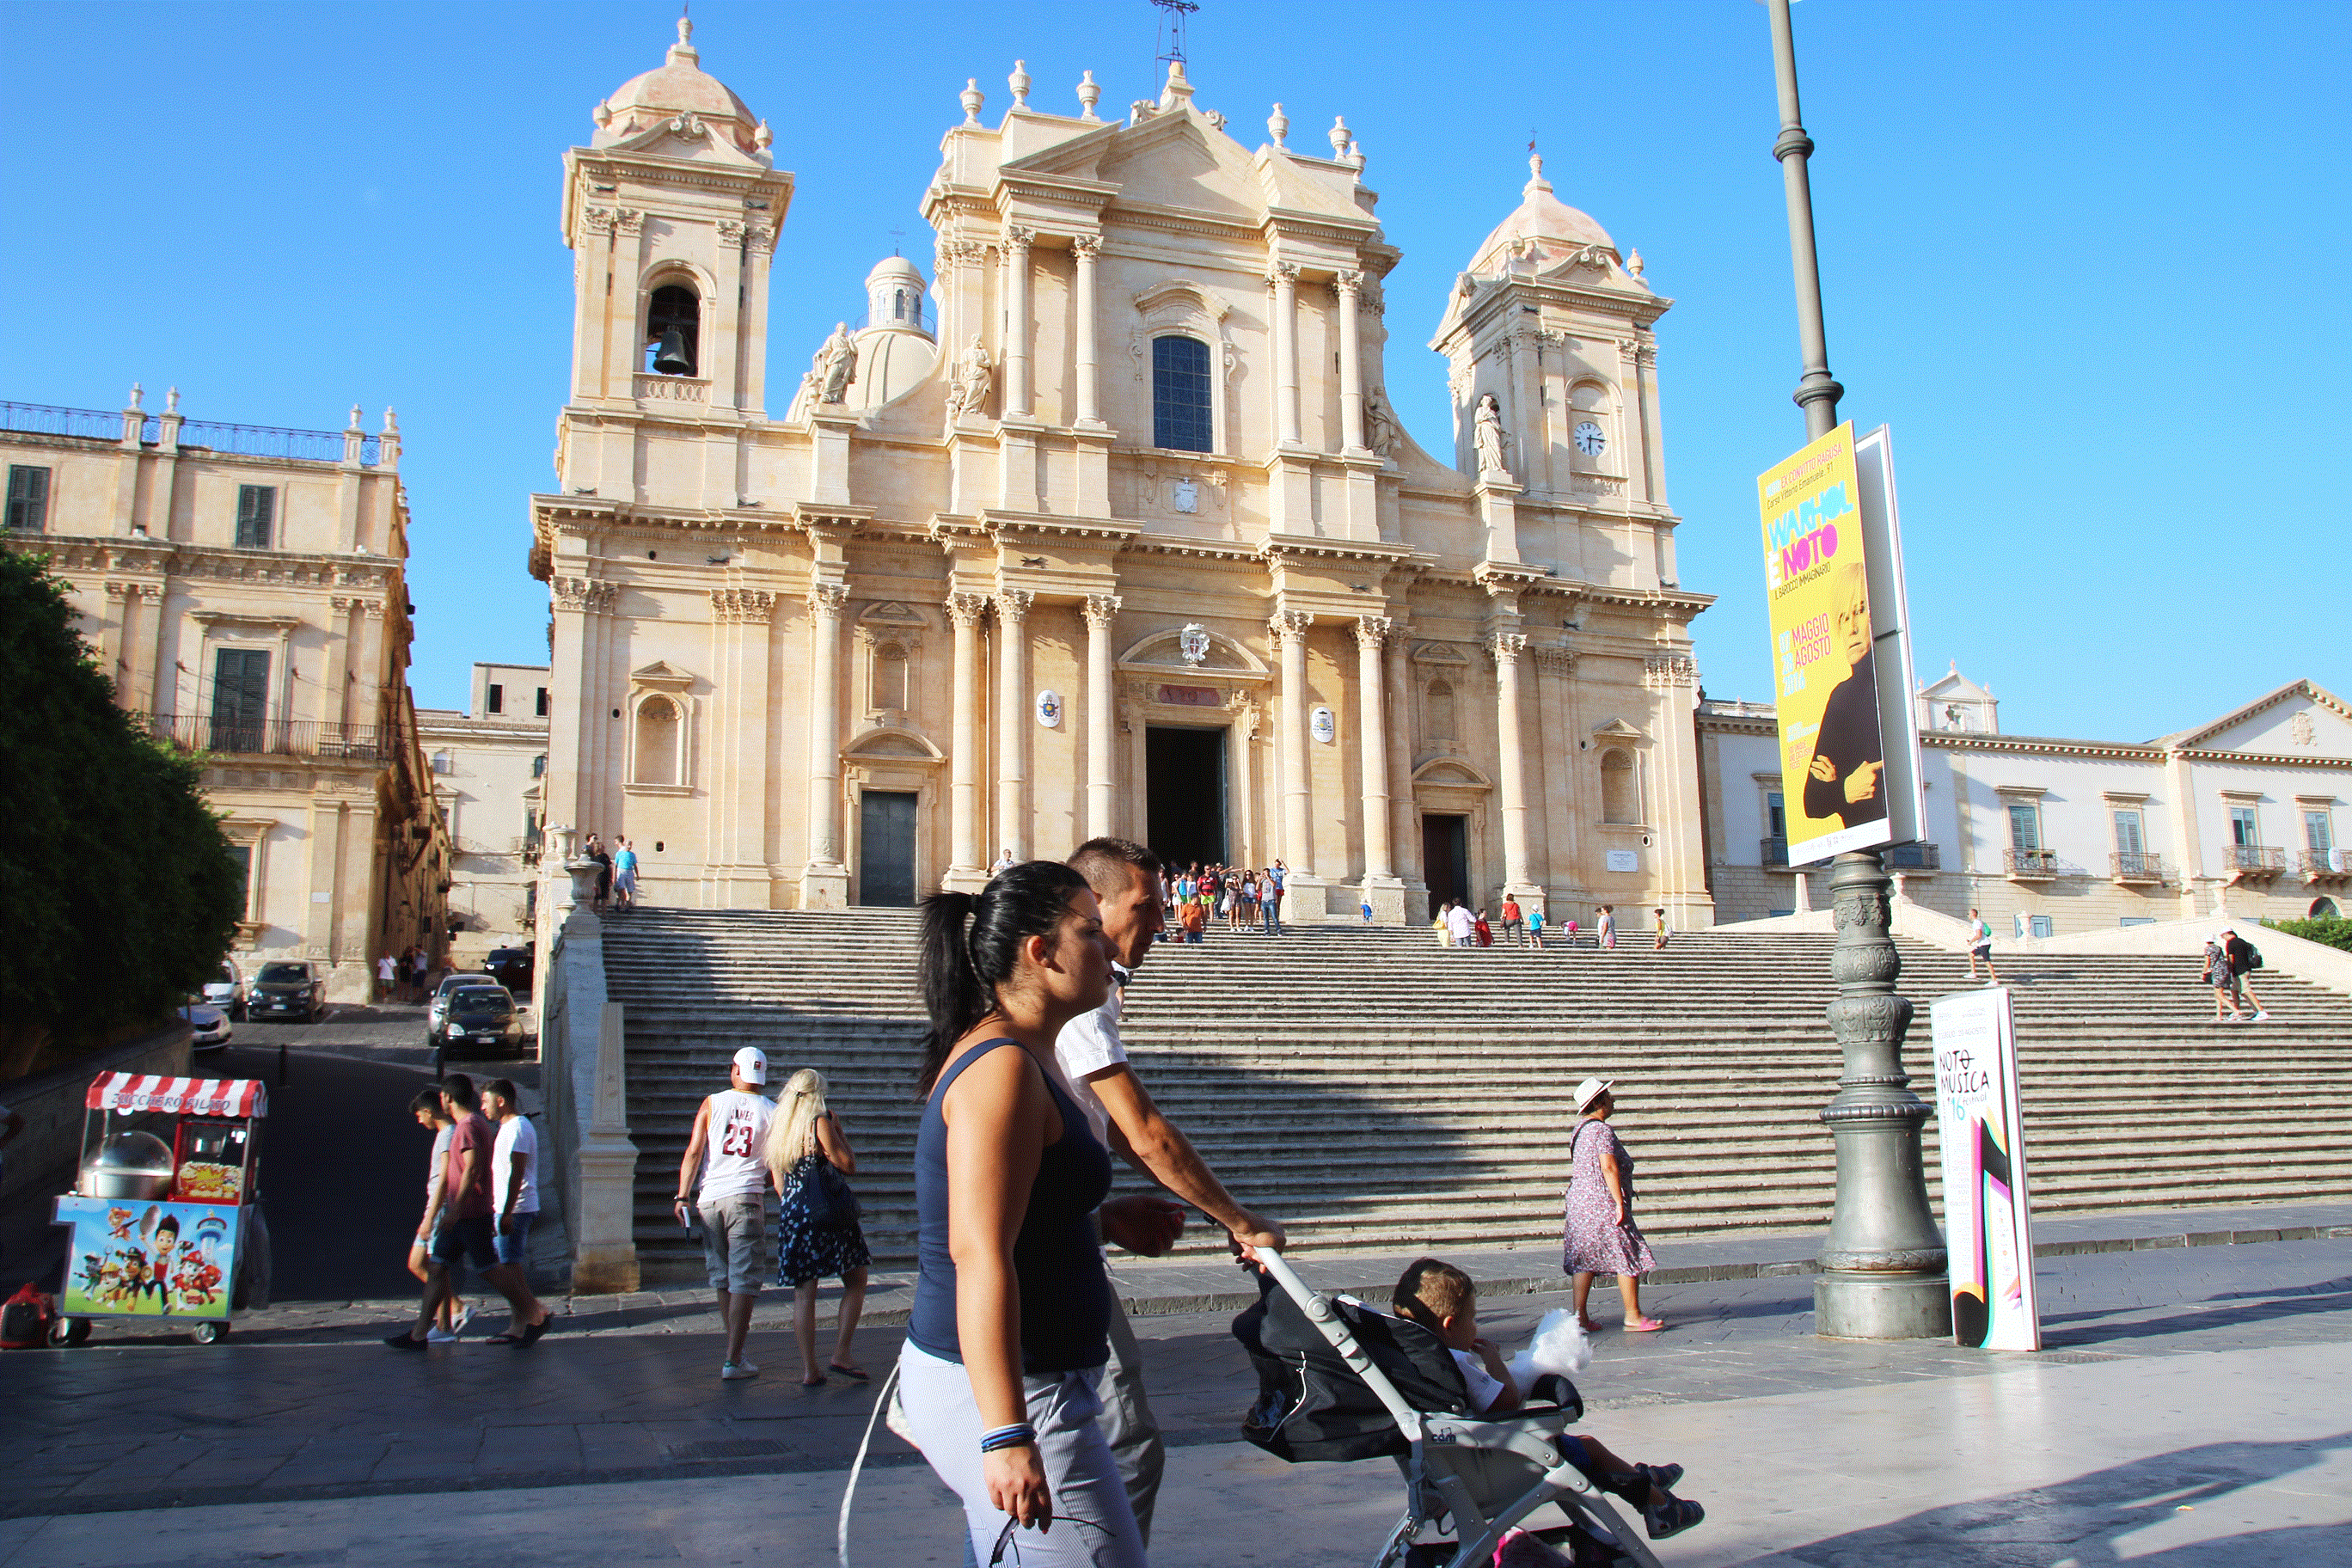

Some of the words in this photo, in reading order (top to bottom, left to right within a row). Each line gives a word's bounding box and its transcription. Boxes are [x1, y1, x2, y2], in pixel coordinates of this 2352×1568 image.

[1781, 475, 1788, 488] EX
[1789, 457, 1816, 483] CONVITTO
[1817, 442, 1842, 467] RAGUSA
[1767, 496, 1780, 510] Corso
[1781, 485, 1798, 499] Vittorio
[1827, 461, 1834, 474] 91
[1767, 480, 1854, 553] WARHOL
[1782, 524, 1838, 581] NOTO
[1779, 579, 1799, 597] BAROCCO
[1792, 612, 1829, 647] MAGGIO
[1795, 634, 1831, 670] AGOSTO
[1782, 669, 1805, 697] 2016
[1939, 1049, 1975, 1073] NOTO
[1940, 1070, 1990, 1094] MUSICA
[111, 1093, 183, 1108] ZUCCHERO
[185, 1098, 230, 1111] FILATO
[1963, 1091, 1987, 1105] festival
[731, 1109, 755, 1122] JAMES
[722, 1124, 754, 1158] 23
